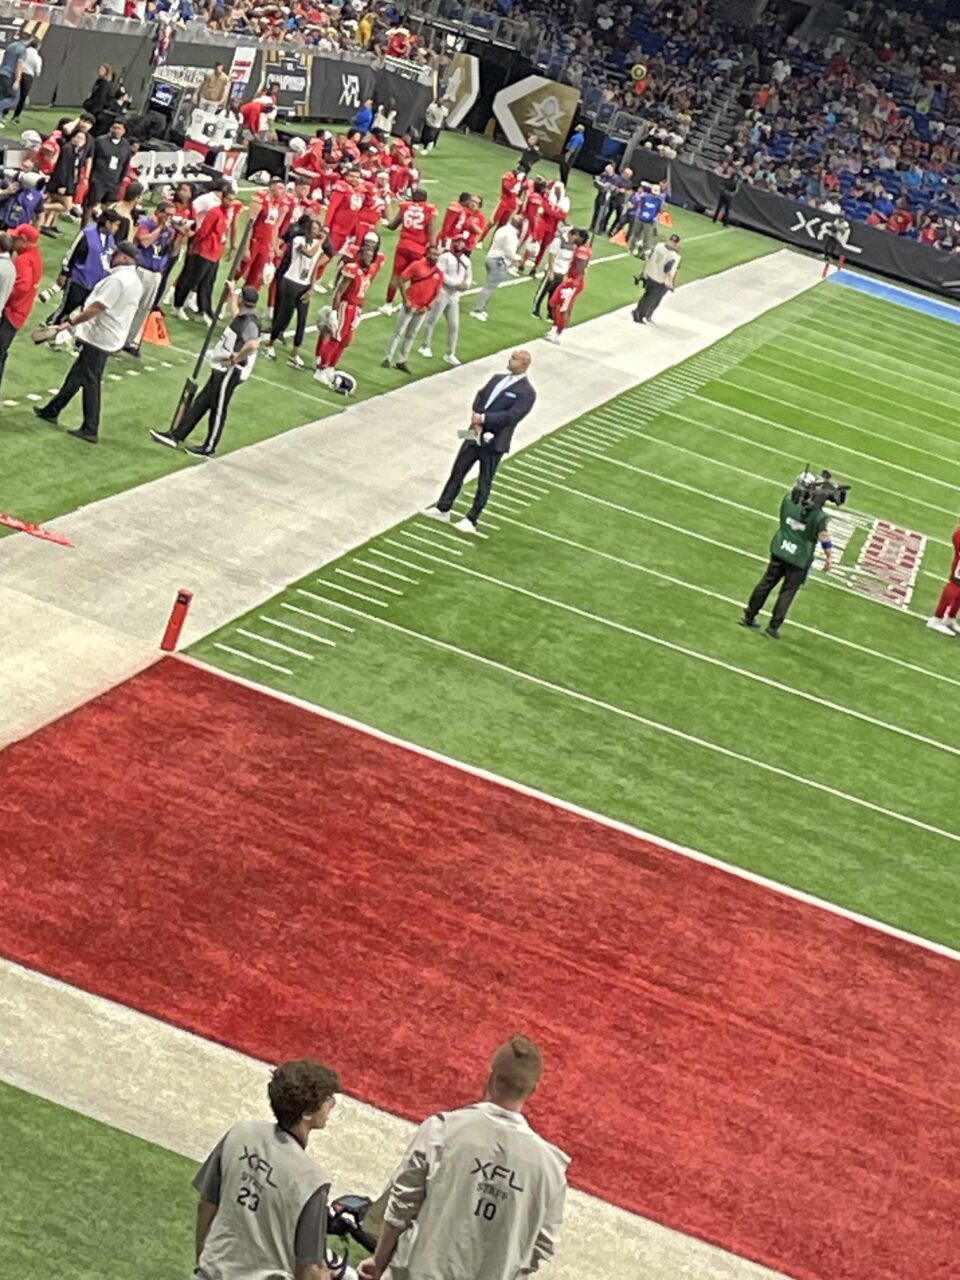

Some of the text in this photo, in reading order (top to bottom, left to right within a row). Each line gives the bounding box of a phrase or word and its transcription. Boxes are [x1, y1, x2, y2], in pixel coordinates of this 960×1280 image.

[404, 210, 425, 230] 62
[238, 1145, 278, 1188] XFL
[470, 1157, 524, 1193] XFL
[236, 1187, 260, 1211] 23
[474, 1197, 497, 1221] 10
